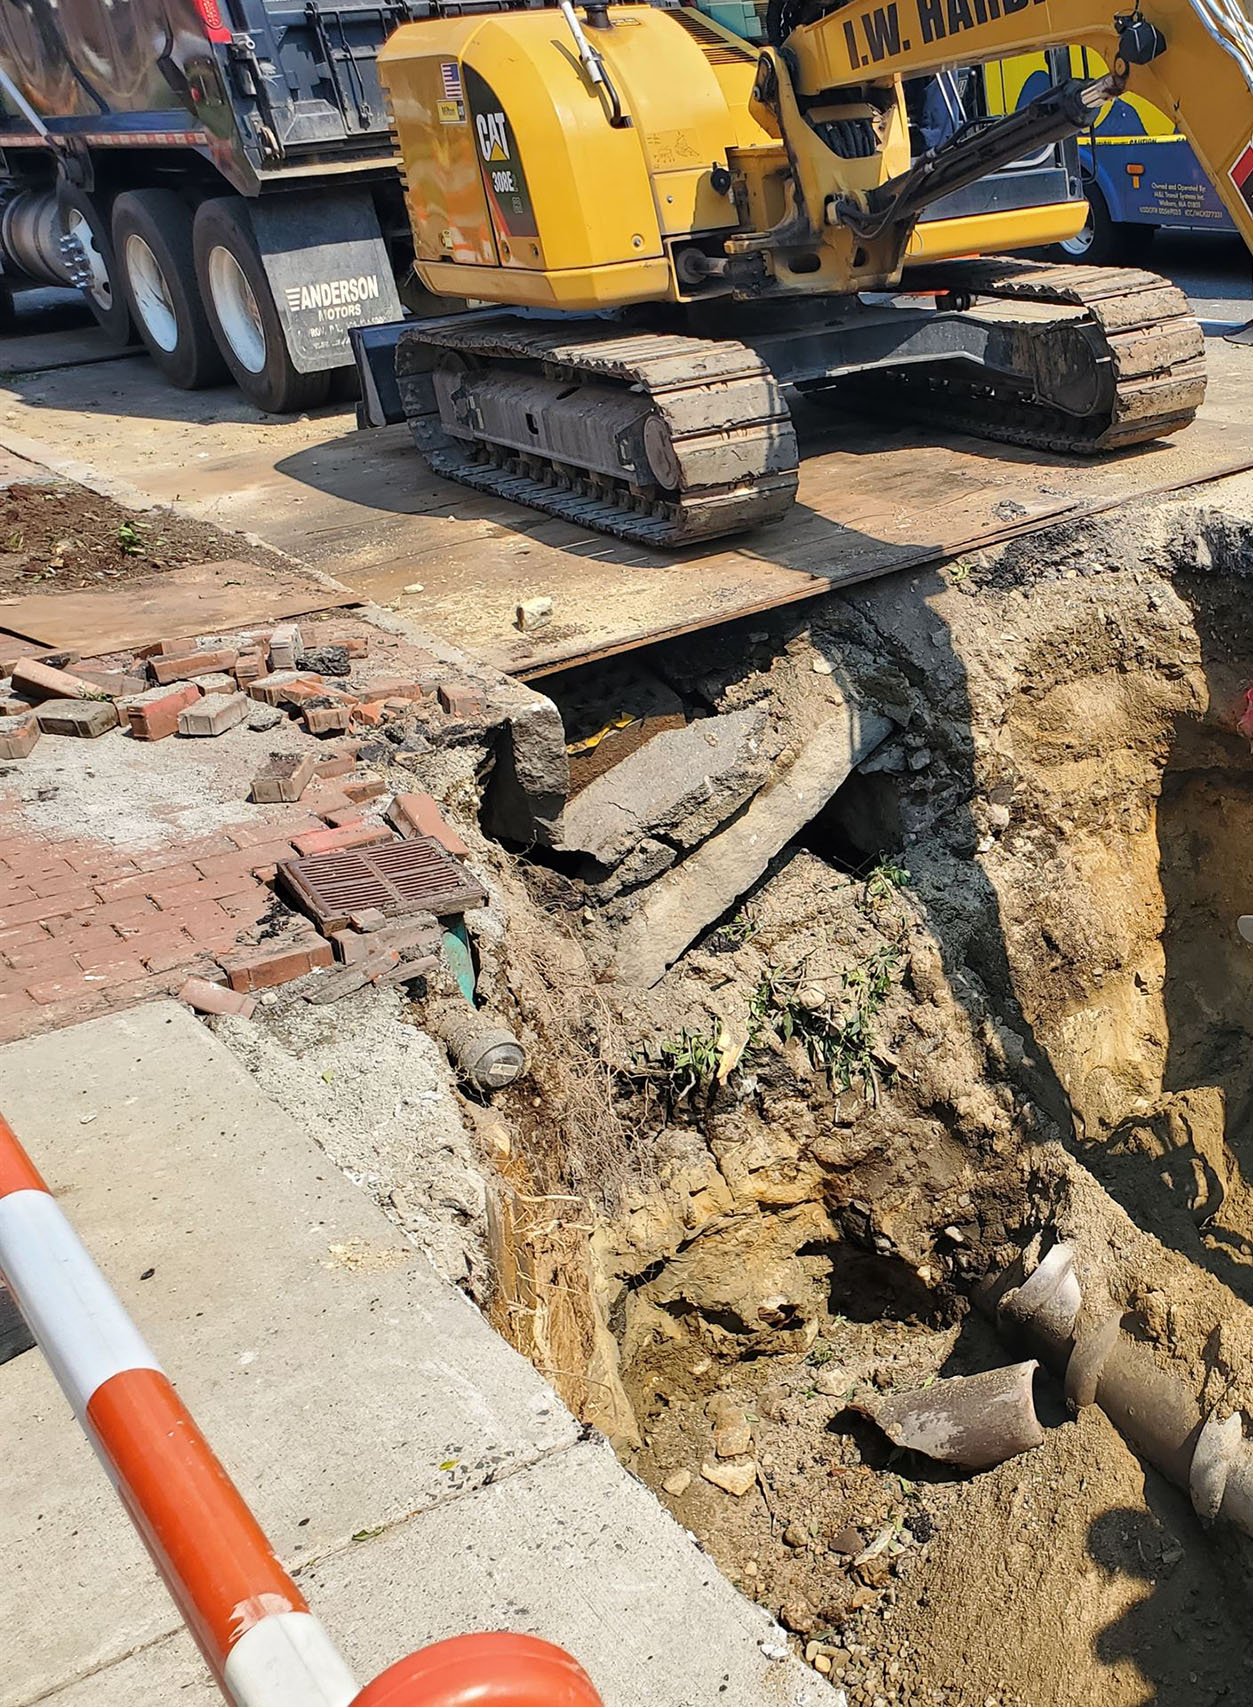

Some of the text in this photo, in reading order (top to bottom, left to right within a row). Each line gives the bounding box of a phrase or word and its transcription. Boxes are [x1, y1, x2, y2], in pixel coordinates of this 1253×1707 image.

[843, 2, 911, 71] I.W.
[476, 112, 511, 161] CAT
[1151, 182, 1167, 190] Owned
[1177, 183, 1198, 192] Operated
[300, 274, 380, 310] ANDERSON
